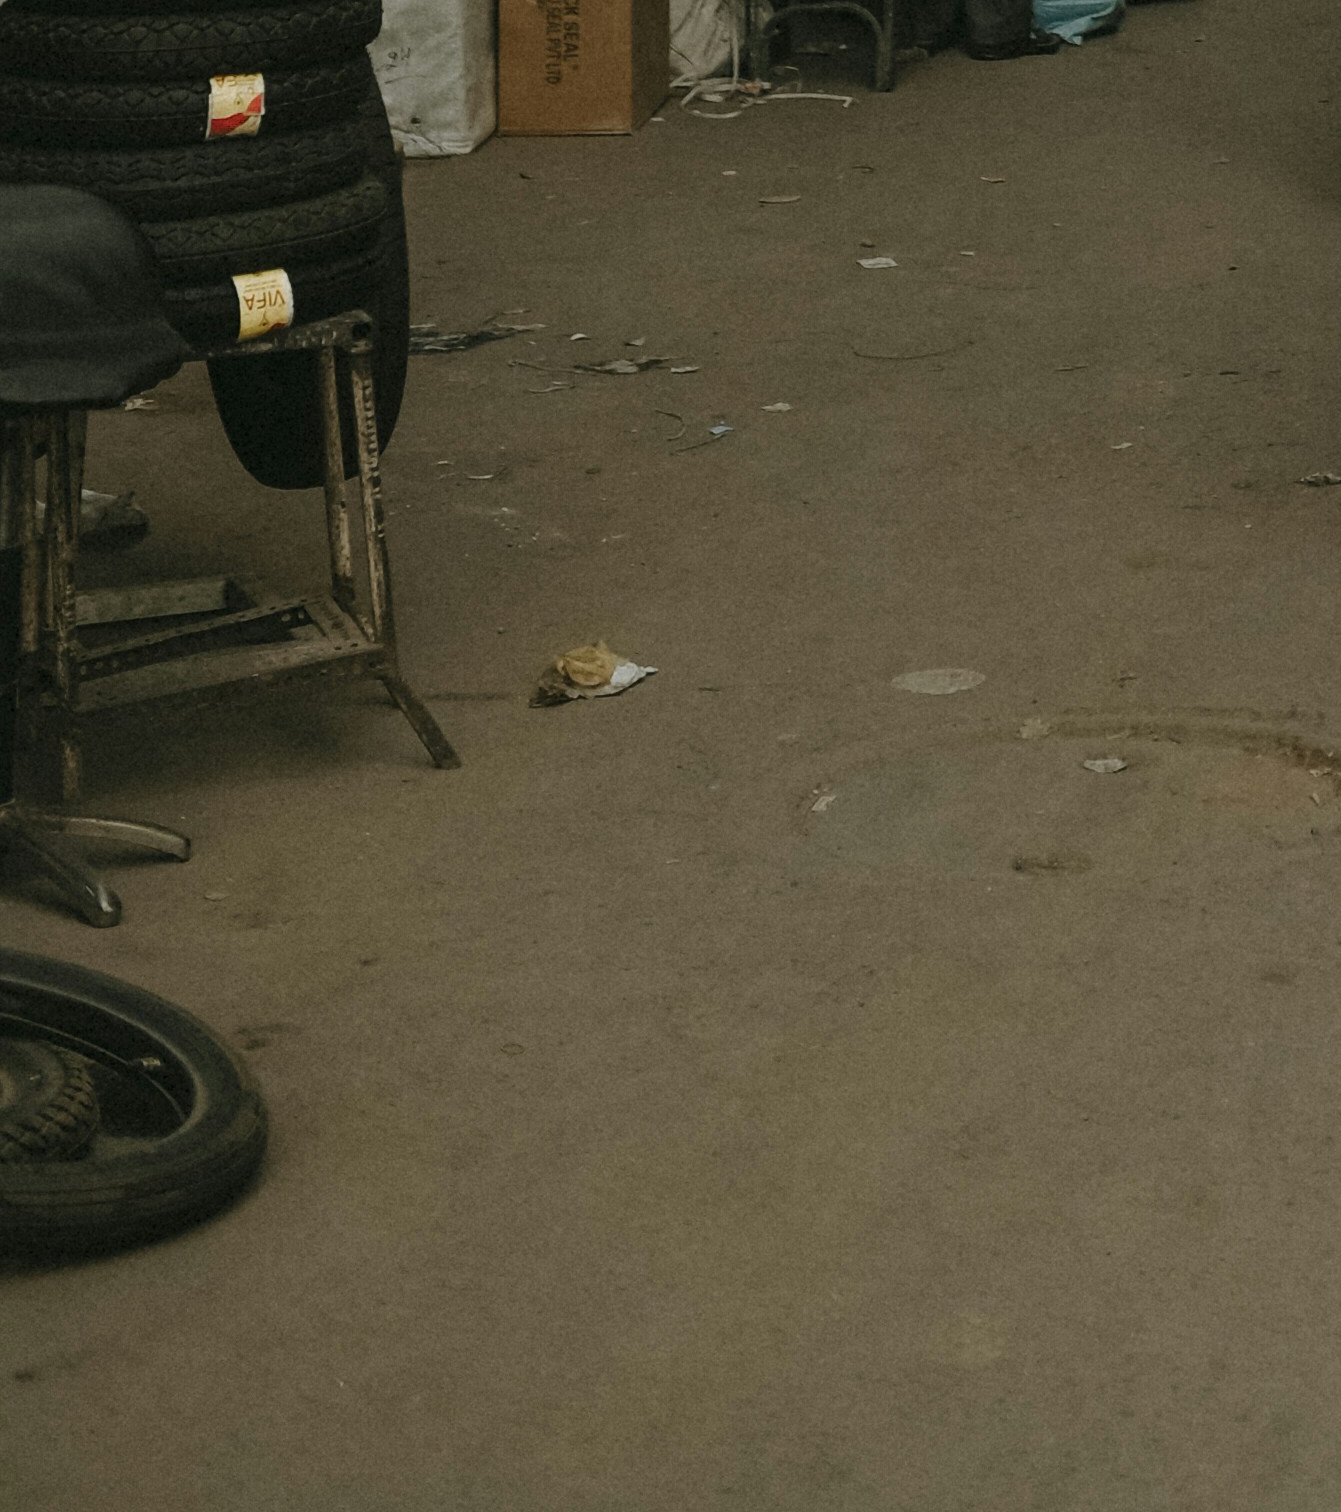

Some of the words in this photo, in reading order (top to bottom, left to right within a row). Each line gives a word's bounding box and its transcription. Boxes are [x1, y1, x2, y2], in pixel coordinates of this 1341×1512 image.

[546, 38, 561, 60] PVT
[563, 22, 580, 62] SEAL
[546, 63, 561, 86] LTD
[243, 289, 286, 311] VIFA
